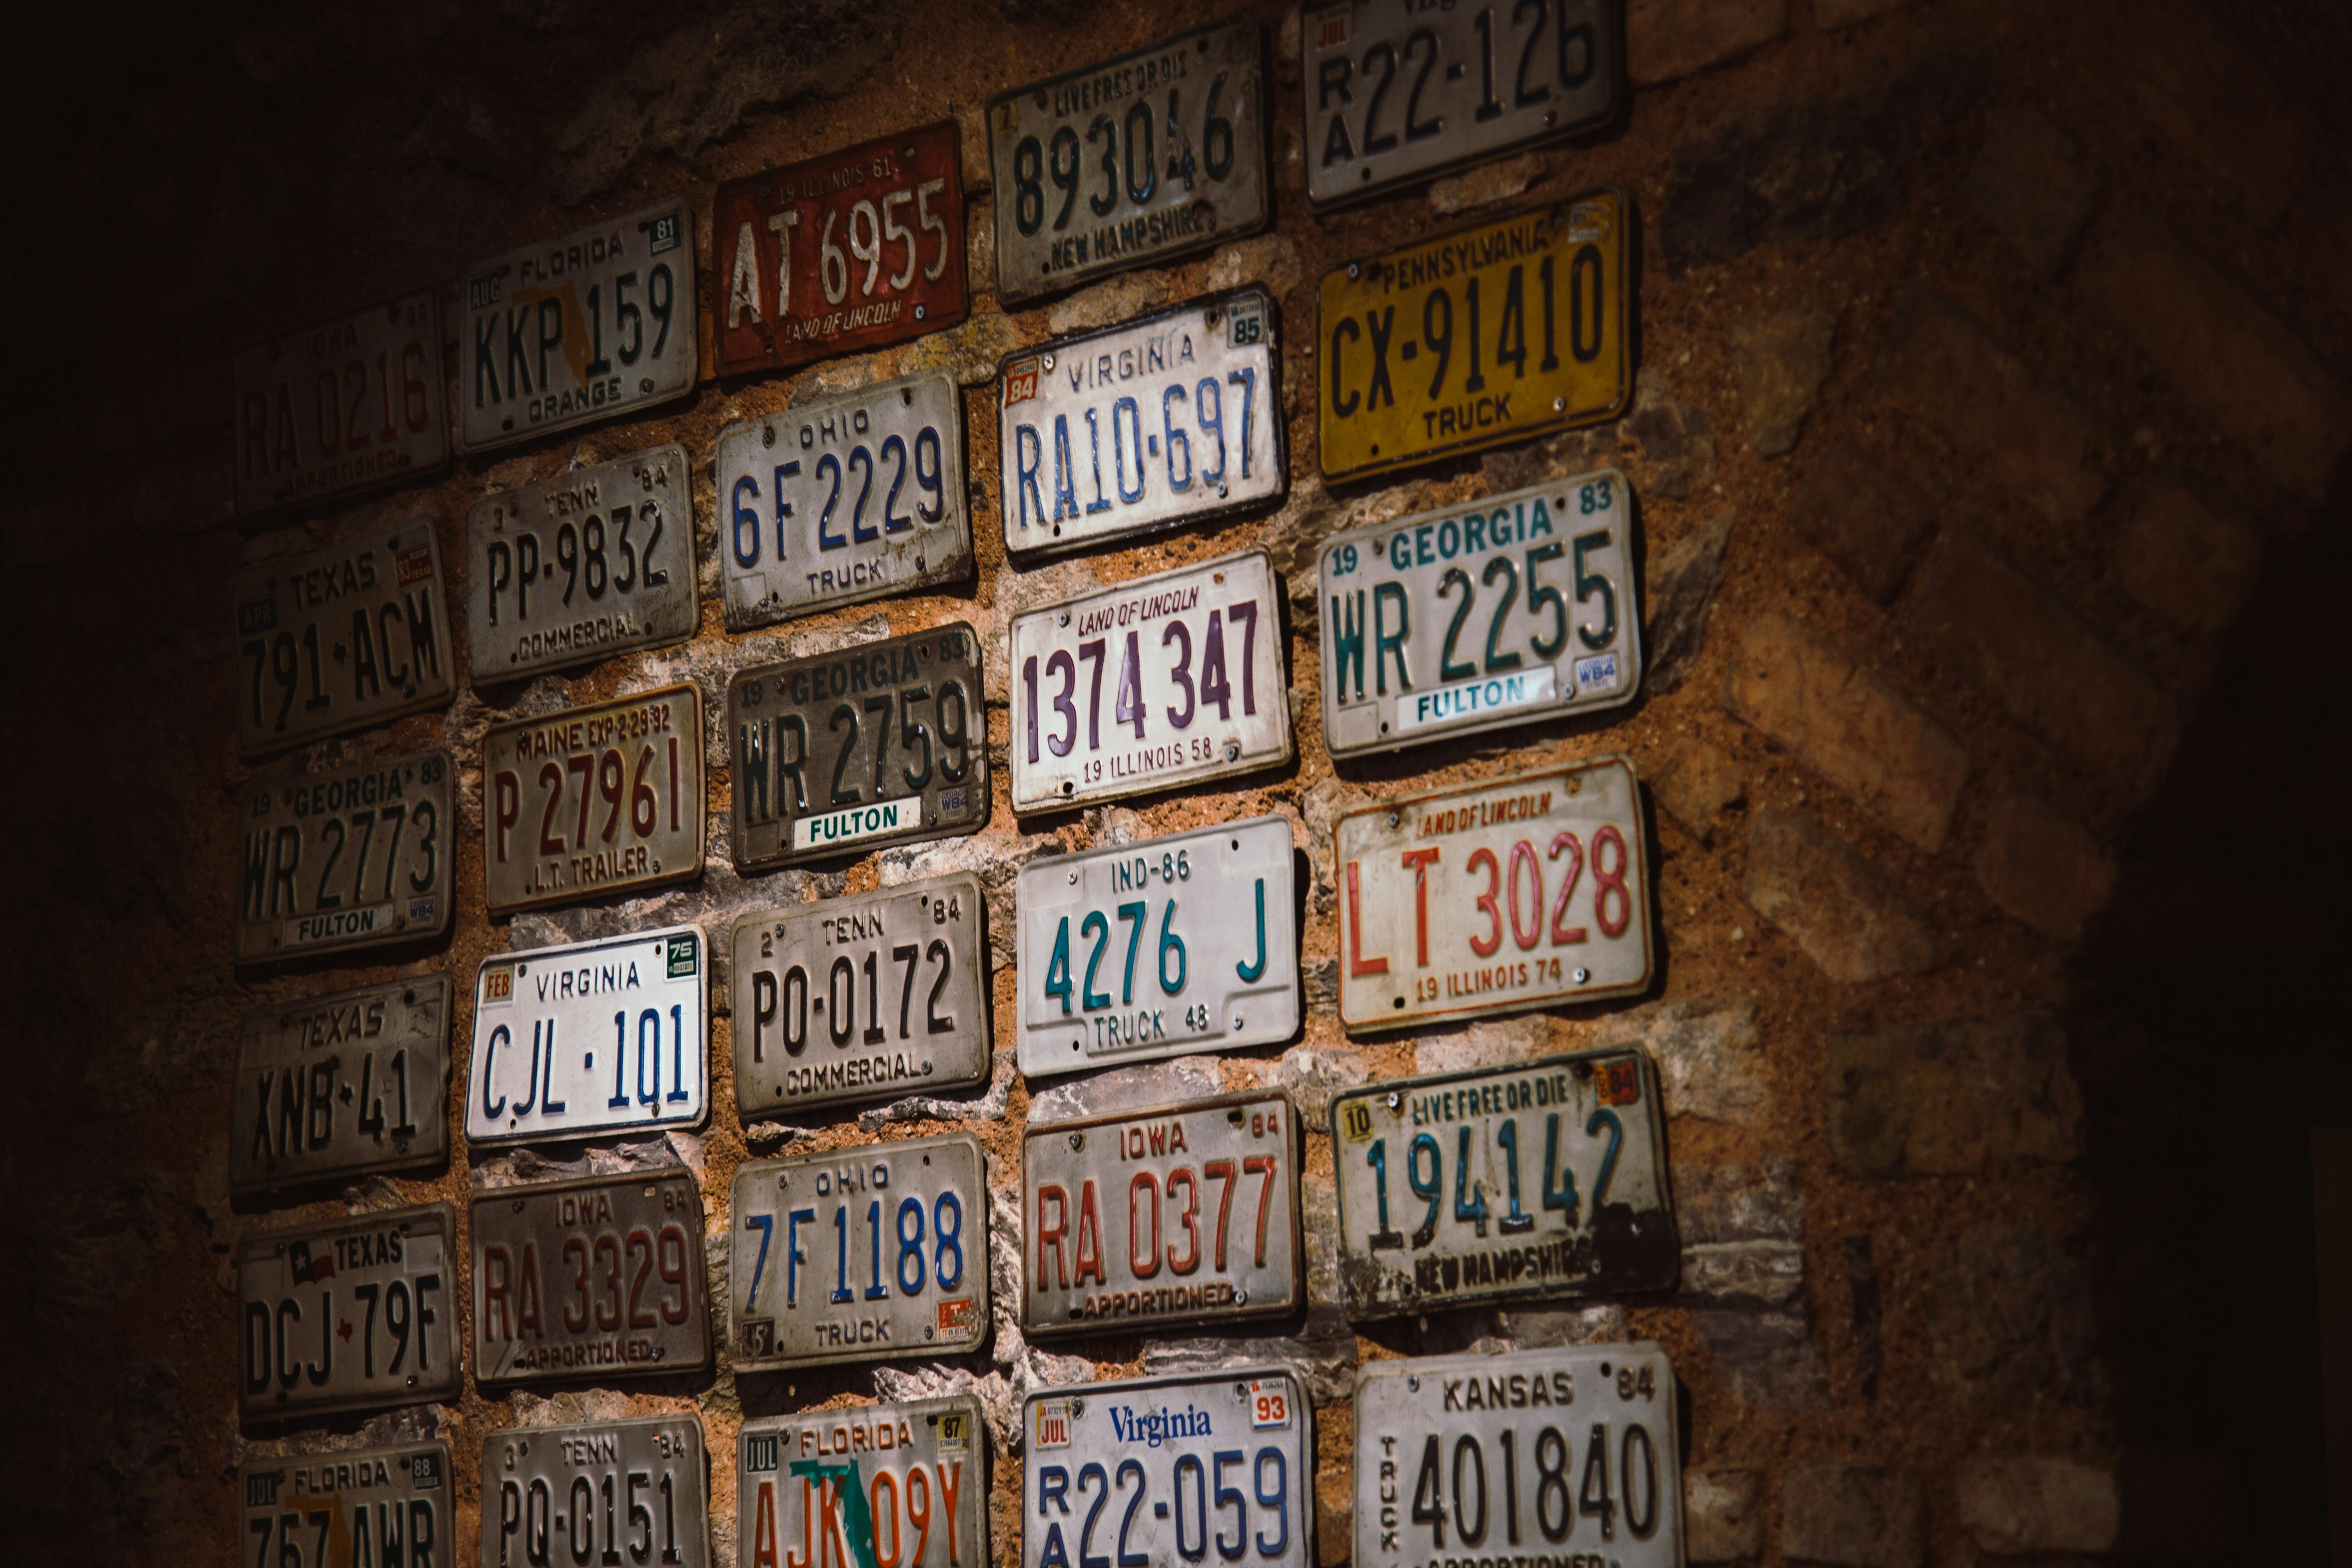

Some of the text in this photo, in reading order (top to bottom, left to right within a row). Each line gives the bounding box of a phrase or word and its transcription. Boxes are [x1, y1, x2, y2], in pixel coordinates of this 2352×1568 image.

[1318, 18, 1347, 48] JUL
[1055, 81, 1089, 118] LIVE
[1136, 63, 1157, 91] OR
[1162, 50, 1187, 83] DIE
[1014, 71, 1234, 238] 893046
[780, 157, 892, 205] 19 ILLINOIS 61
[657, 217, 674, 240] 81
[521, 233, 622, 285] FLORIDA
[728, 177, 948, 329] AT 6955
[1051, 233, 1088, 271] NEW
[1384, 219, 1549, 294] PENNSYLVANIA
[471, 275, 499, 309] AUG
[475, 263, 674, 408] KKP 159
[785, 300, 901, 345] LAND OF LINCOLN
[1235, 316, 1259, 344] 85
[1332, 245, 1604, 418] CX-91410
[307, 322, 358, 363] IOWA
[1069, 335, 1194, 392] VIRGINIA
[244, 341, 428, 477] RA 0216
[529, 378, 621, 422] ORANGE
[1010, 377, 1034, 402] 84
[800, 409, 868, 448] OHIO
[1422, 392, 1512, 438] TRUCK
[285, 449, 396, 494] APPORTIONED
[642, 465, 667, 491] 84
[545, 480, 600, 517] TENN
[733, 426, 943, 568] 6F2229
[1580, 480, 1613, 515] 83
[1391, 498, 1554, 571] GEORGIA
[410, 565, 431, 579] TEXAS
[487, 499, 668, 627] PP-9832
[807, 560, 881, 593] TRUCK
[1332, 544, 1358, 576] 19
[290, 551, 375, 610] TEXAS
[245, 604, 271, 628] APR
[1078, 586, 1199, 637] LAND OF LINCOLN
[1332, 529, 1616, 704] WR 2255
[519, 613, 640, 659] COMMERCIAL
[940, 634, 965, 663] 83
[741, 681, 763, 707] 19
[791, 645, 919, 706] GEORGIA
[1418, 677, 1525, 722] FULTON
[516, 723, 583, 762] MAINE
[740, 680, 969, 821] WR 2759
[1084, 737, 1212, 783] 19 ILLINOIS 58
[421, 758, 442, 784] 83
[252, 793, 271, 817] 19
[294, 768, 403, 818] GEORGIA
[495, 738, 679, 862] P 27961
[941, 788, 968, 800] GEORGIA
[810, 805, 898, 842] FULTON
[1416, 792, 1552, 837] LAND OF LINCOLN
[243, 800, 437, 919] WR 2773
[571, 847, 649, 885] TRAILER
[1112, 849, 1190, 893] IND-86
[933, 896, 960, 924] 84
[1467, 825, 1630, 957] 3028
[299, 910, 374, 941] FULTON
[761, 931, 773, 958] 2
[822, 909, 883, 945] TENN
[669, 941, 693, 960] 75
[1046, 878, 1266, 1013] 4276 J
[487, 973, 509, 998] FEB
[537, 961, 639, 1001] VIRGINIA
[1417, 958, 1561, 1001] 19 ILLINOIS 74
[300, 1002, 385, 1051] TEXAS
[1094, 1004, 1209, 1047] TRUCK 48
[787, 1052, 923, 1095] COMMERCIAL
[1609, 1069, 1632, 1093] 84
[1412, 1091, 1453, 1125] LIVE
[1458, 1084, 1502, 1117] FREE
[1507, 1079, 1532, 1110] OR
[1537, 1074, 1567, 1104] DIE
[1120, 1122, 1187, 1160] IOWA
[1252, 1112, 1278, 1138] 84
[1347, 1108, 1371, 1138] 10
[817, 1164, 888, 1194] OHIO
[1368, 1108, 1623, 1252] 194142
[556, 1195, 612, 1227] IOWA
[664, 1190, 686, 1212] 84
[1037, 1156, 1276, 1292] RA 0377
[335, 1231, 403, 1271] TEXAS
[746, 1191, 963, 1313] 7F1188
[485, 1226, 689, 1342] RA 3329
[1083, 1283, 1232, 1318] APPORTIONED
[815, 1320, 890, 1347] TRUCK
[526, 1339, 651, 1369] APPORTIONED
[1444, 1372, 1573, 1412] KANSAS
[1618, 1365, 1655, 1402] 84
[944, 1417, 961, 1438] 87
[1109, 1404, 1212, 1448] Virginia
[1256, 1396, 1285, 1421] 93
[560, 1434, 617, 1465] TENN
[660, 1430, 684, 1459] 84
[801, 1422, 913, 1457] FLORIDA
[1042, 1419, 1067, 1443] JUL
[414, 1457, 430, 1476] 88
[505, 1444, 514, 1470] 3
[748, 1440, 776, 1471] JUL
[250, 1476, 275, 1505] JUL
[295, 1461, 390, 1495] FLORIDA
[1381, 1437, 1398, 1550] TRUCK
[1412, 1423, 1656, 1548] 401840
[354, 1498, 435, 1568] AWR
[755, 1461, 961, 1568] AJK 09Y
